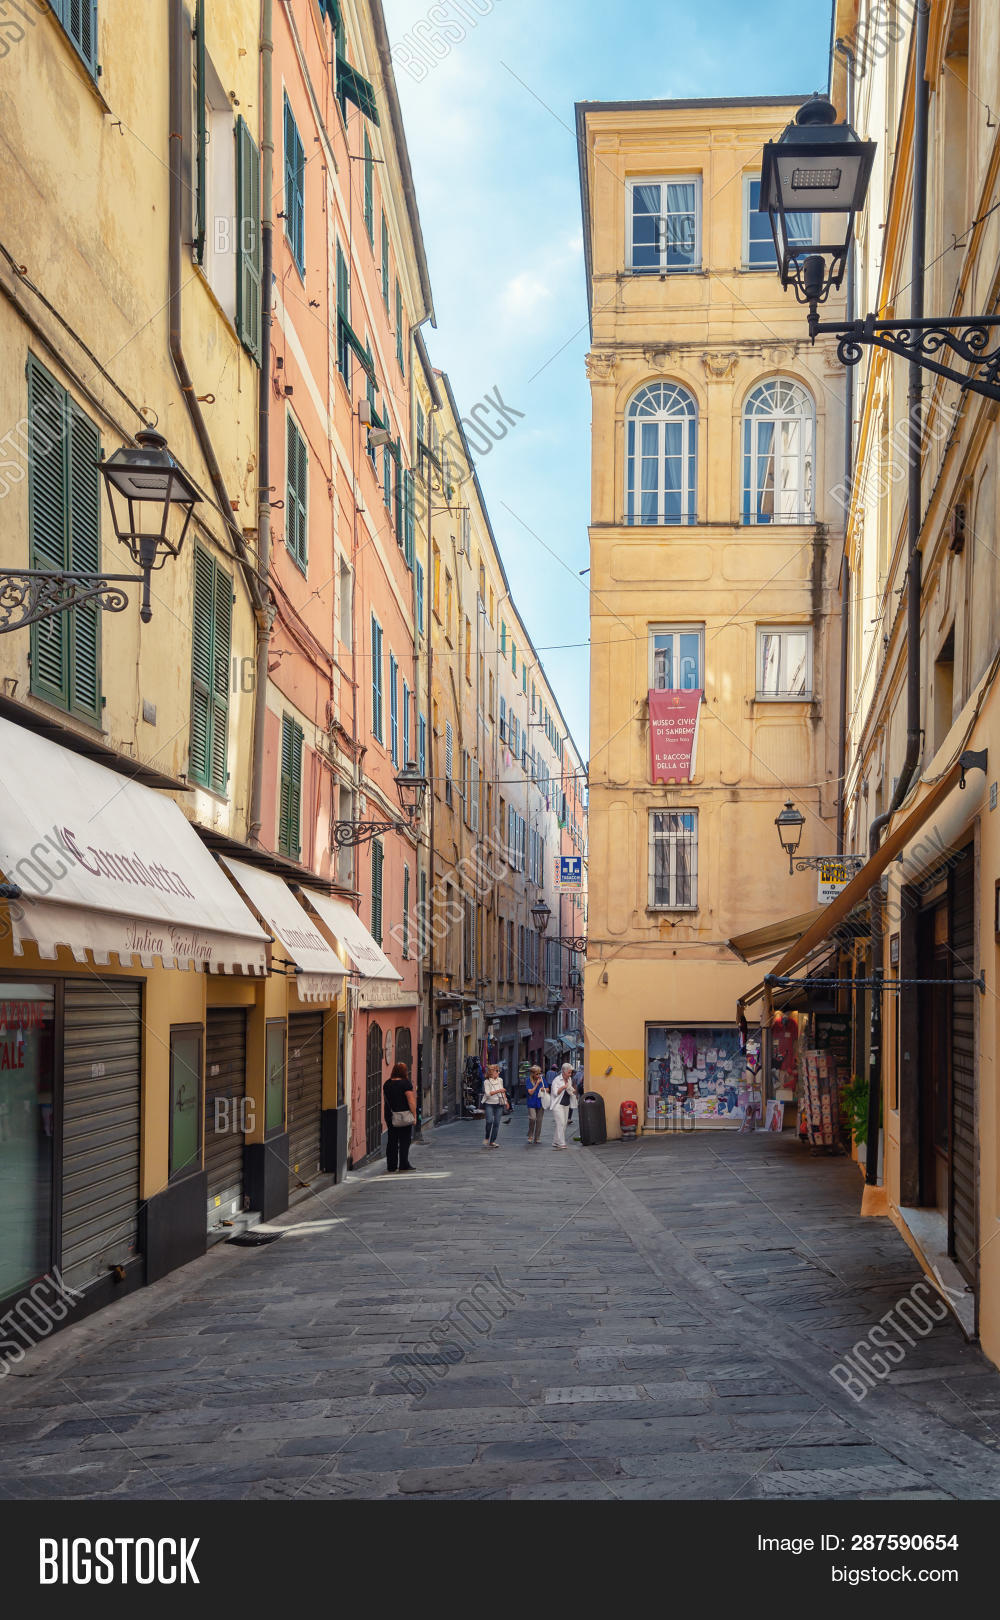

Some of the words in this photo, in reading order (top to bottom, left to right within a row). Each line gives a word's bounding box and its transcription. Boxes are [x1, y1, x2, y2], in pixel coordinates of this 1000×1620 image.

[652, 719, 675, 727] MUSEO
[60, 826, 195, 900] Cannoletta
[126, 920, 163, 952] Antica
[0, 1041, 24, 1070] ALE
